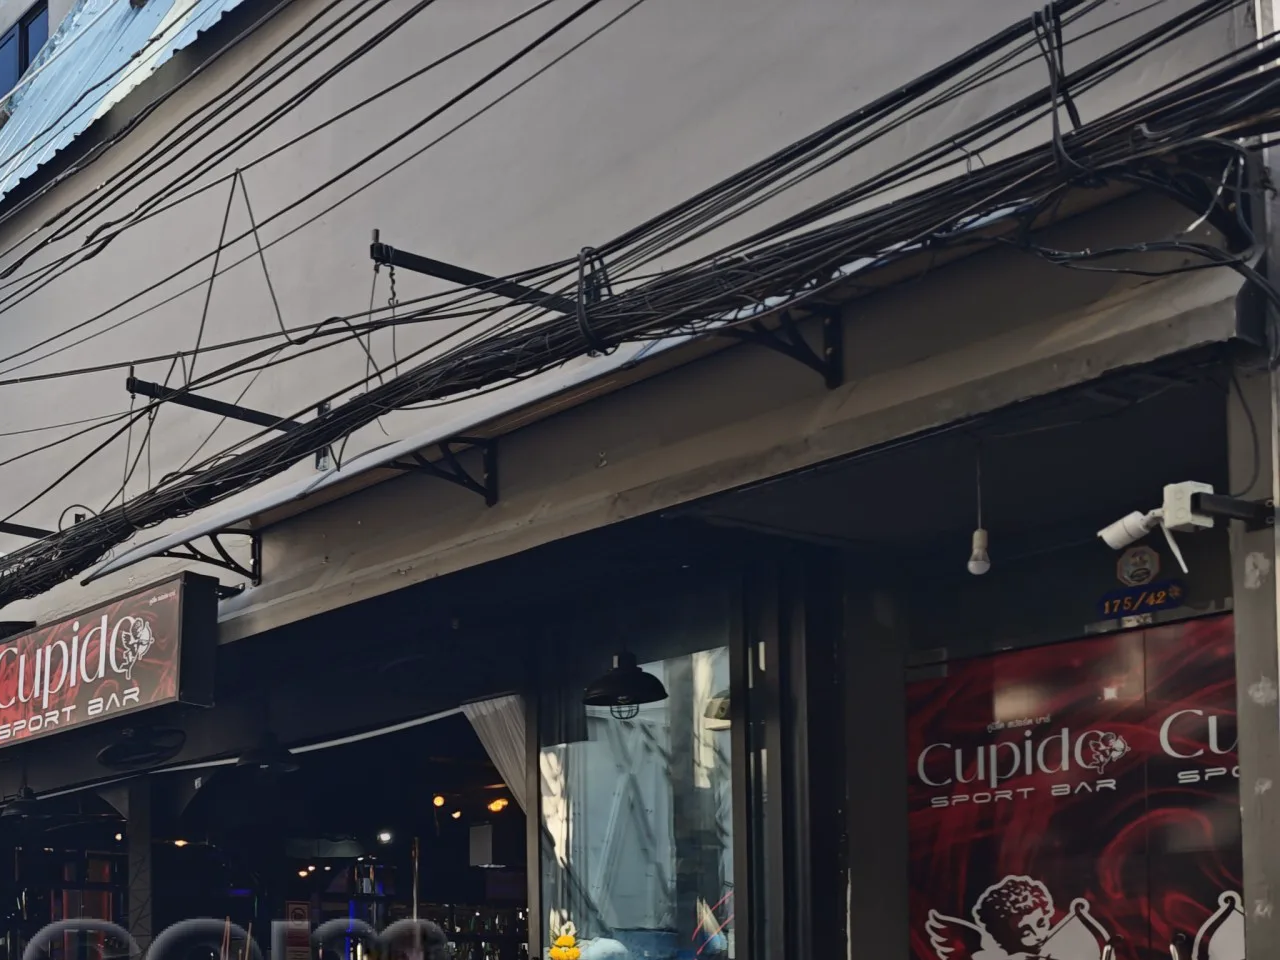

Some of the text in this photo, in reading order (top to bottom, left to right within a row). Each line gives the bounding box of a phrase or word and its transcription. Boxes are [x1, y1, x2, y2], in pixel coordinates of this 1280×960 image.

[87, 686, 140, 716] BAR
[917, 727, 1117, 789] Cupido
[930, 778, 1117, 808] SPORT BAR
